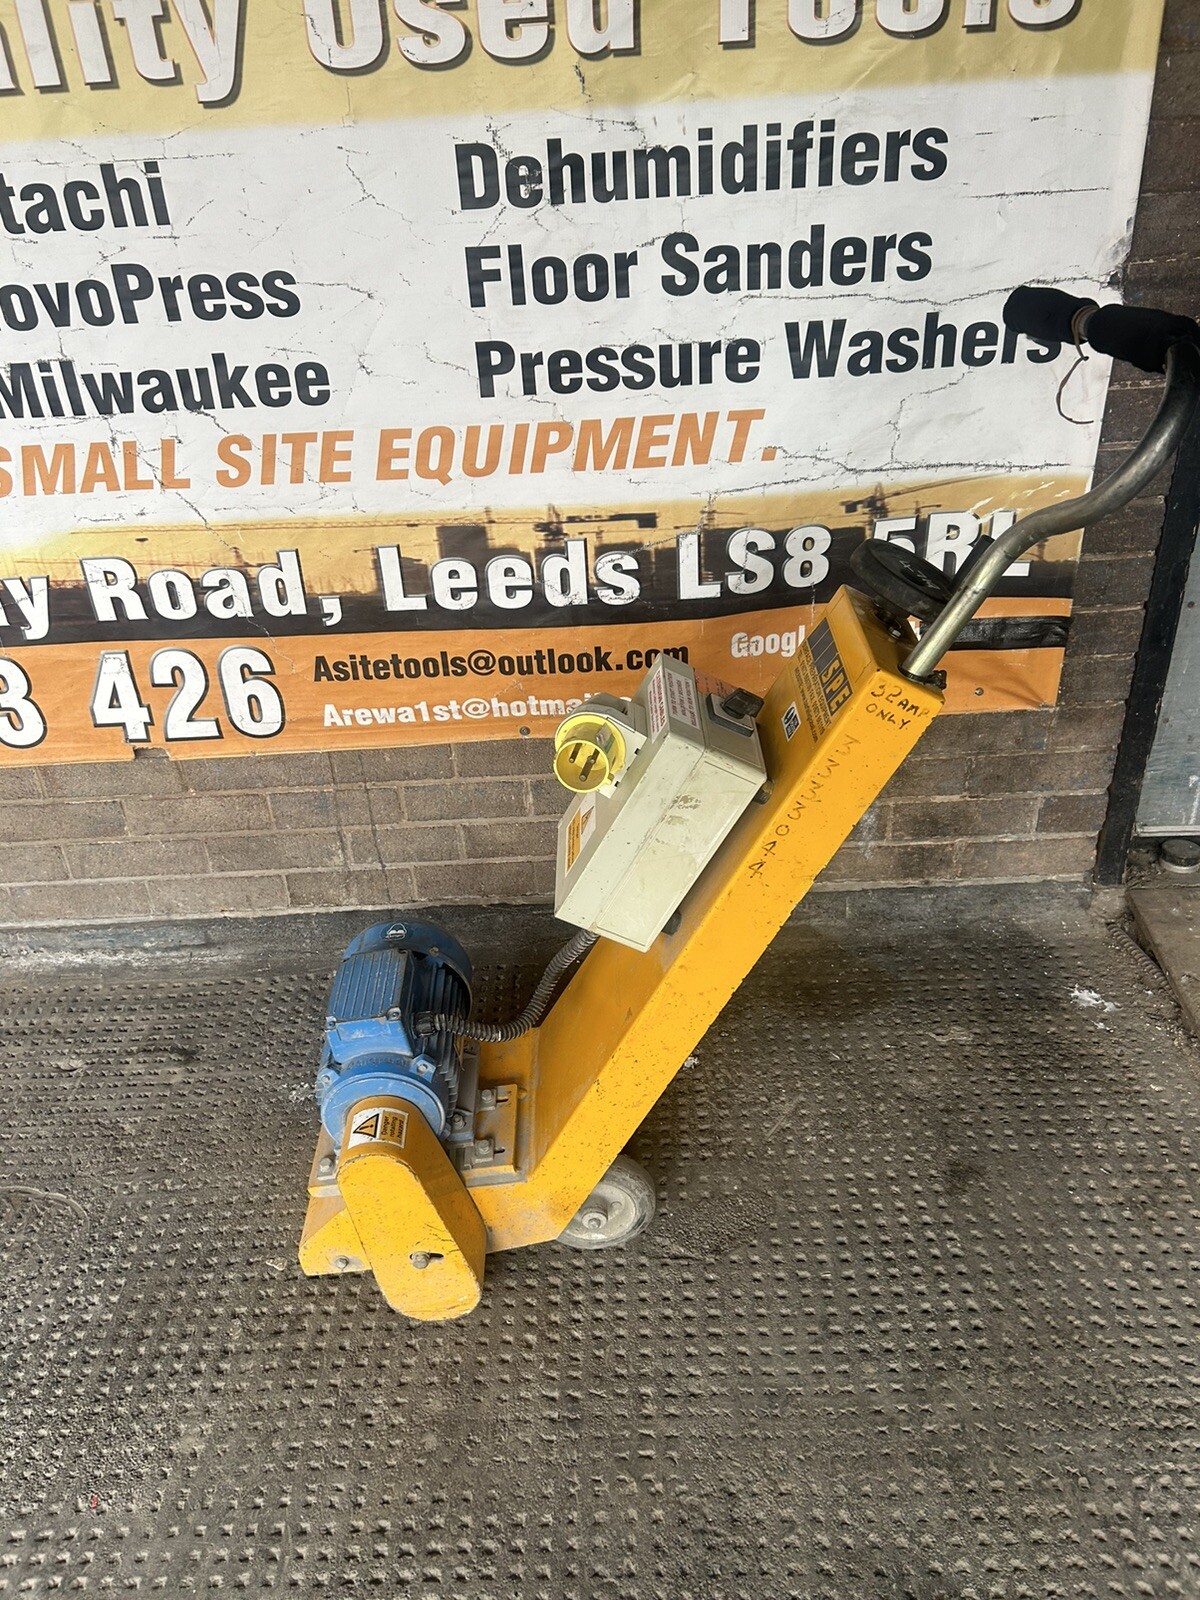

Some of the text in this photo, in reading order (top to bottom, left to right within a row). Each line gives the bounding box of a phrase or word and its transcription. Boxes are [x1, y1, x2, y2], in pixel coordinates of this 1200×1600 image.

[0, 0, 245, 105] lity
[455, 120, 949, 211] Dehumidifiers
[465, 223, 933, 308] Floor Sanders
[474, 311, 1062, 398] Pressure Washers
[215, 431, 354, 489] SITE
[376, 409, 779, 486] EQUIPMENT.
[0, 576, 50, 640] y
[79, 549, 343, 627] Road,
[376, 538, 641, 612] Leeds
[676, 524, 833, 601] LS8
[90, 646, 286, 744] 426
[313, 645, 689, 683] Asitetools@outlook.com
[820, 658, 850, 713] SPE
[865, 703, 912, 730] ONLY
